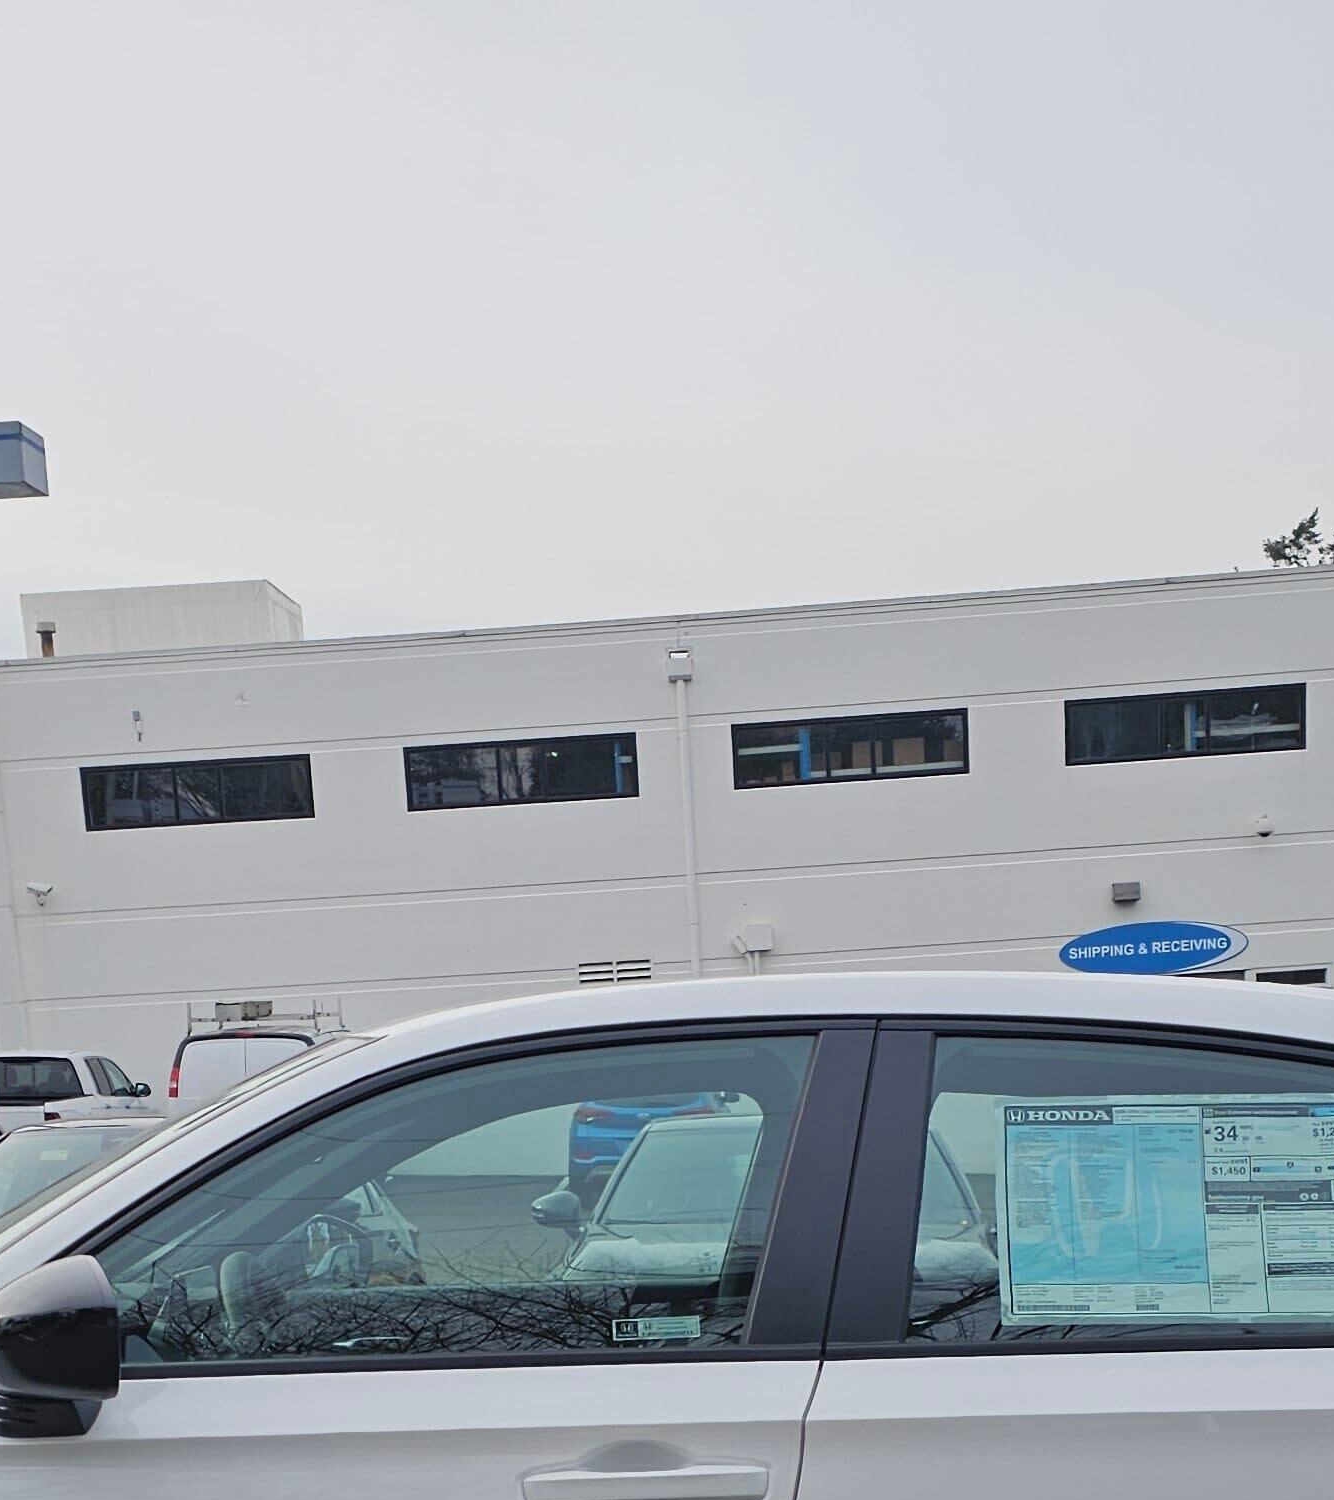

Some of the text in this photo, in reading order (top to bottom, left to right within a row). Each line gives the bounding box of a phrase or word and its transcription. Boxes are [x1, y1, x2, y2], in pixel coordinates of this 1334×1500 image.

[1069, 937, 1228, 960] SHIPPING & RECEIVING
[1026, 1110, 1111, 1121] HONDA
[1214, 1125, 1238, 1141] 34
[1211, 1166, 1246, 1176] $1,450
